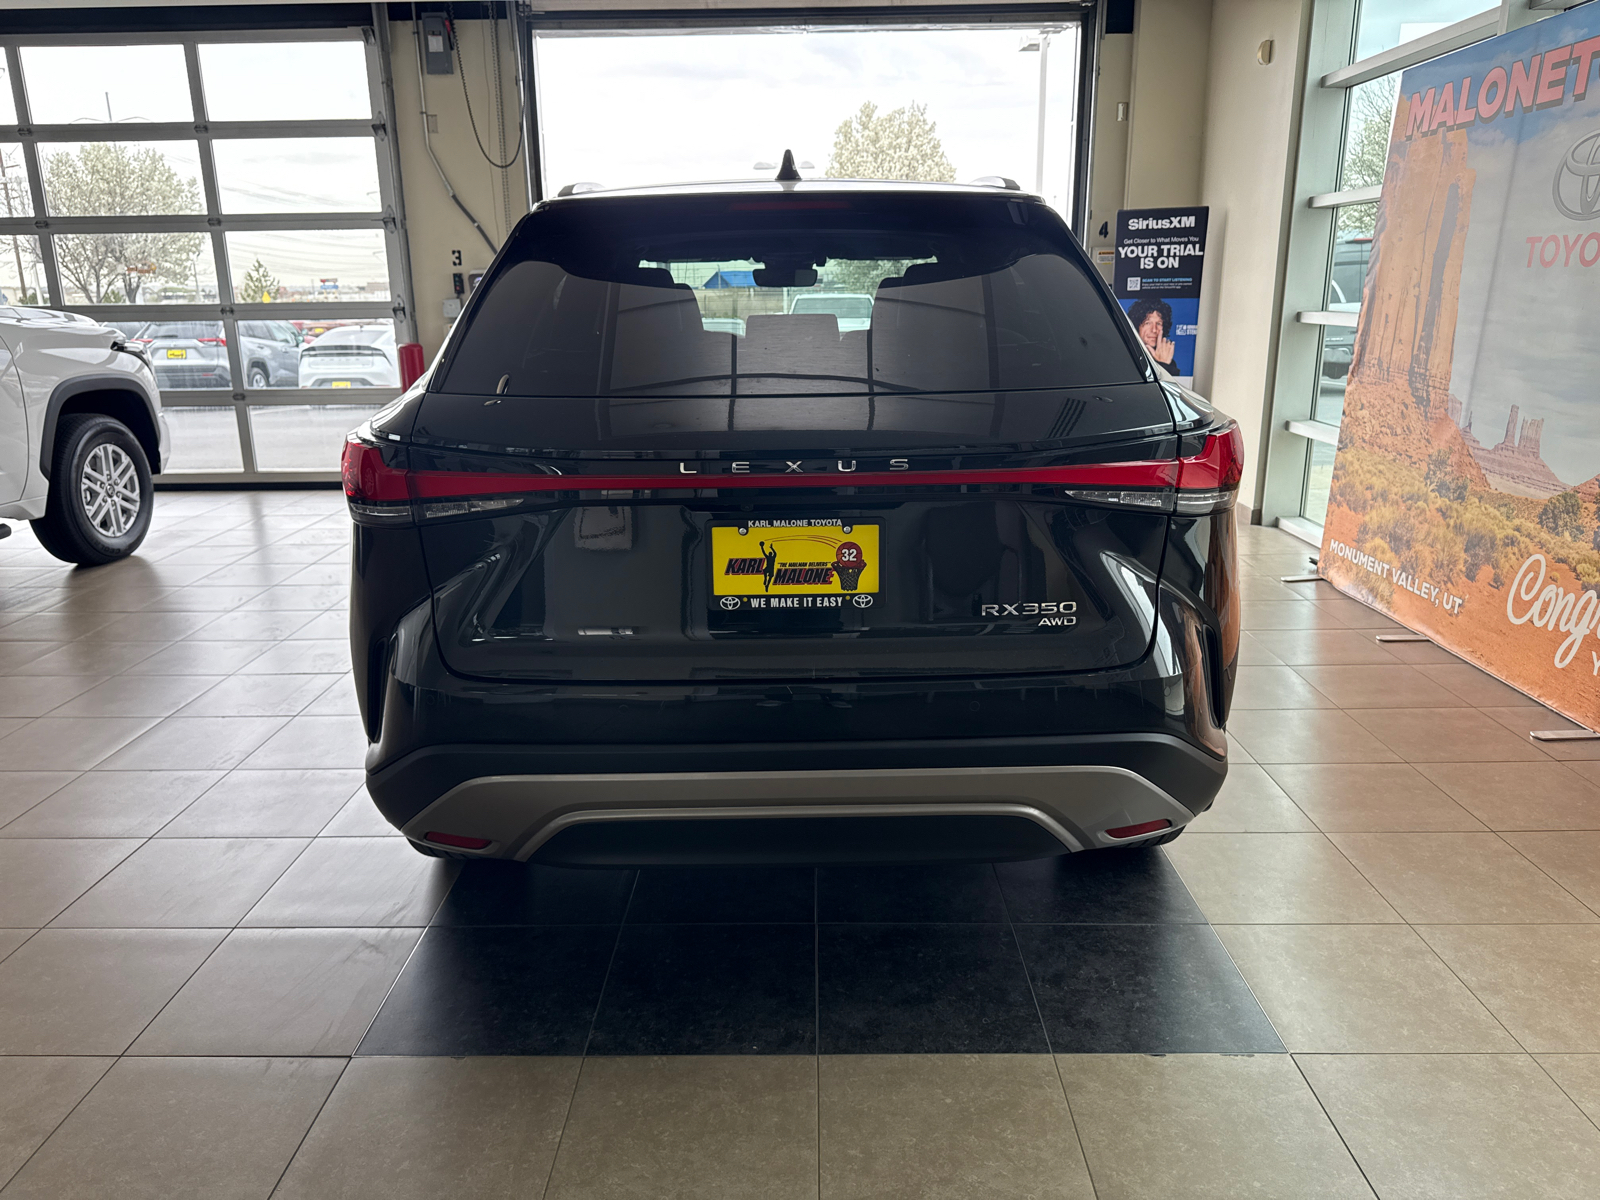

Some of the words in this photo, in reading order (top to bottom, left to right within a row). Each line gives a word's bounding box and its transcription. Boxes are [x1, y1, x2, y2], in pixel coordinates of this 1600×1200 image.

[1099, 221, 1109, 239] 4
[1128, 216, 1196, 230] SiriusXM
[1118, 245, 1158, 258] YOUR
[1160, 244, 1204, 257] TRIAL
[1526, 231, 1600, 269] TOYO
[452, 250, 462, 266] 3
[1140, 258, 1154, 269] IS
[1157, 256, 1179, 269] ON
[679, 458, 909, 474] LEXUS
[841, 548, 857, 561] 32
[725, 558, 765, 575] KARL
[773, 568, 834, 585] MALONE
[1329, 539, 1390, 578] MONUMENT
[1392, 567, 1439, 607] VALLEY,
[1442, 591, 1463, 614] UT
[751, 598, 766, 608] WE
[770, 597, 799, 608] MAKE
[804, 597, 812, 607] IT
[816, 597, 843, 607] EASY
[981, 601, 1077, 616] RX350
[1038, 616, 1076, 626] AWD
